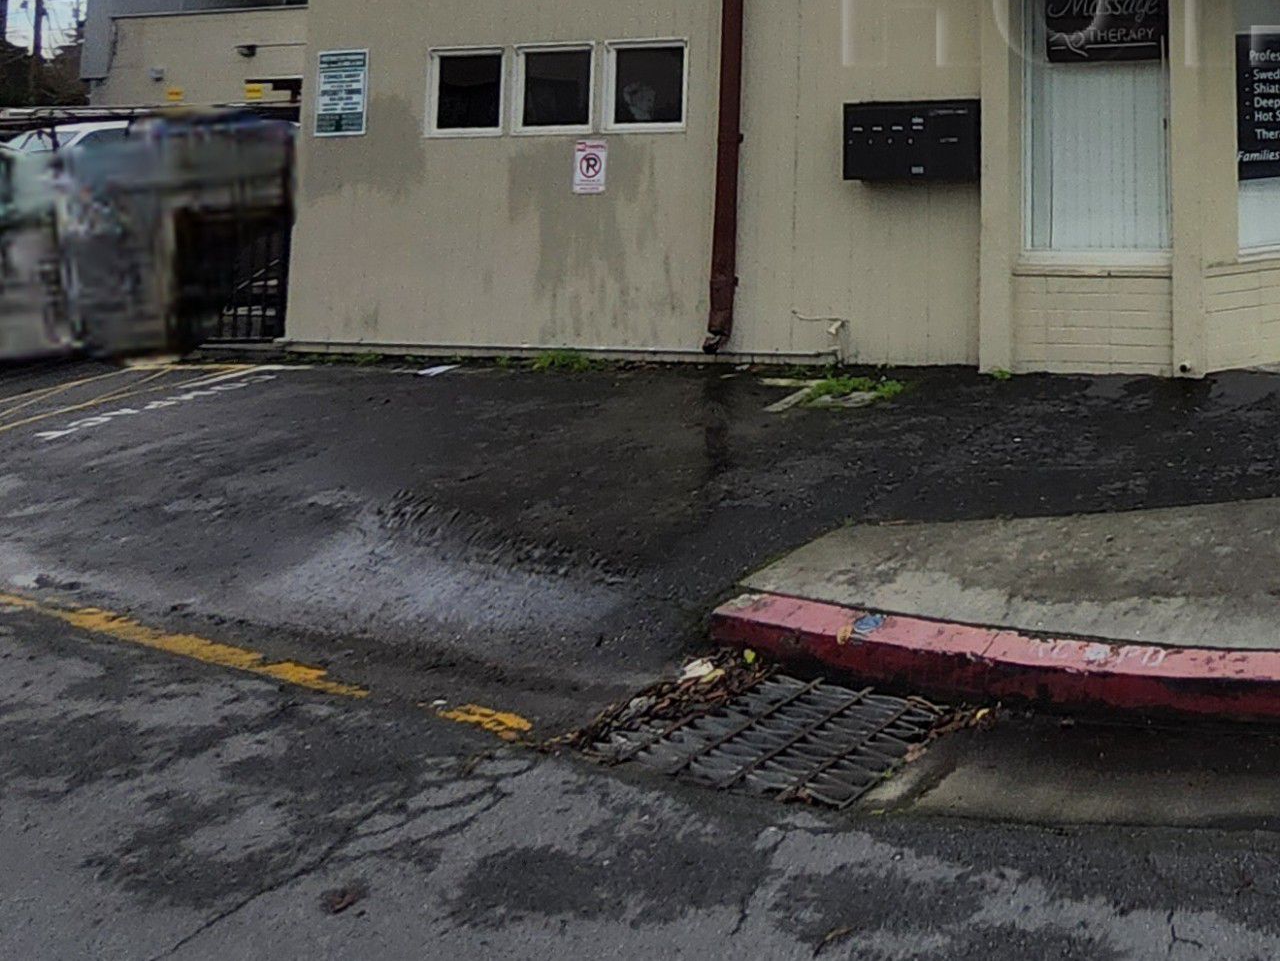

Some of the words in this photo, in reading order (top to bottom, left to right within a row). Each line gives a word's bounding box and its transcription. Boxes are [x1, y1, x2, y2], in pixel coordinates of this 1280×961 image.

[1089, 27, 1154, 42] THERAPY
[1253, 96, 1280, 108] Deep
[1254, 110, 1273, 122] Hot
[1237, 150, 1280, 162] Families
